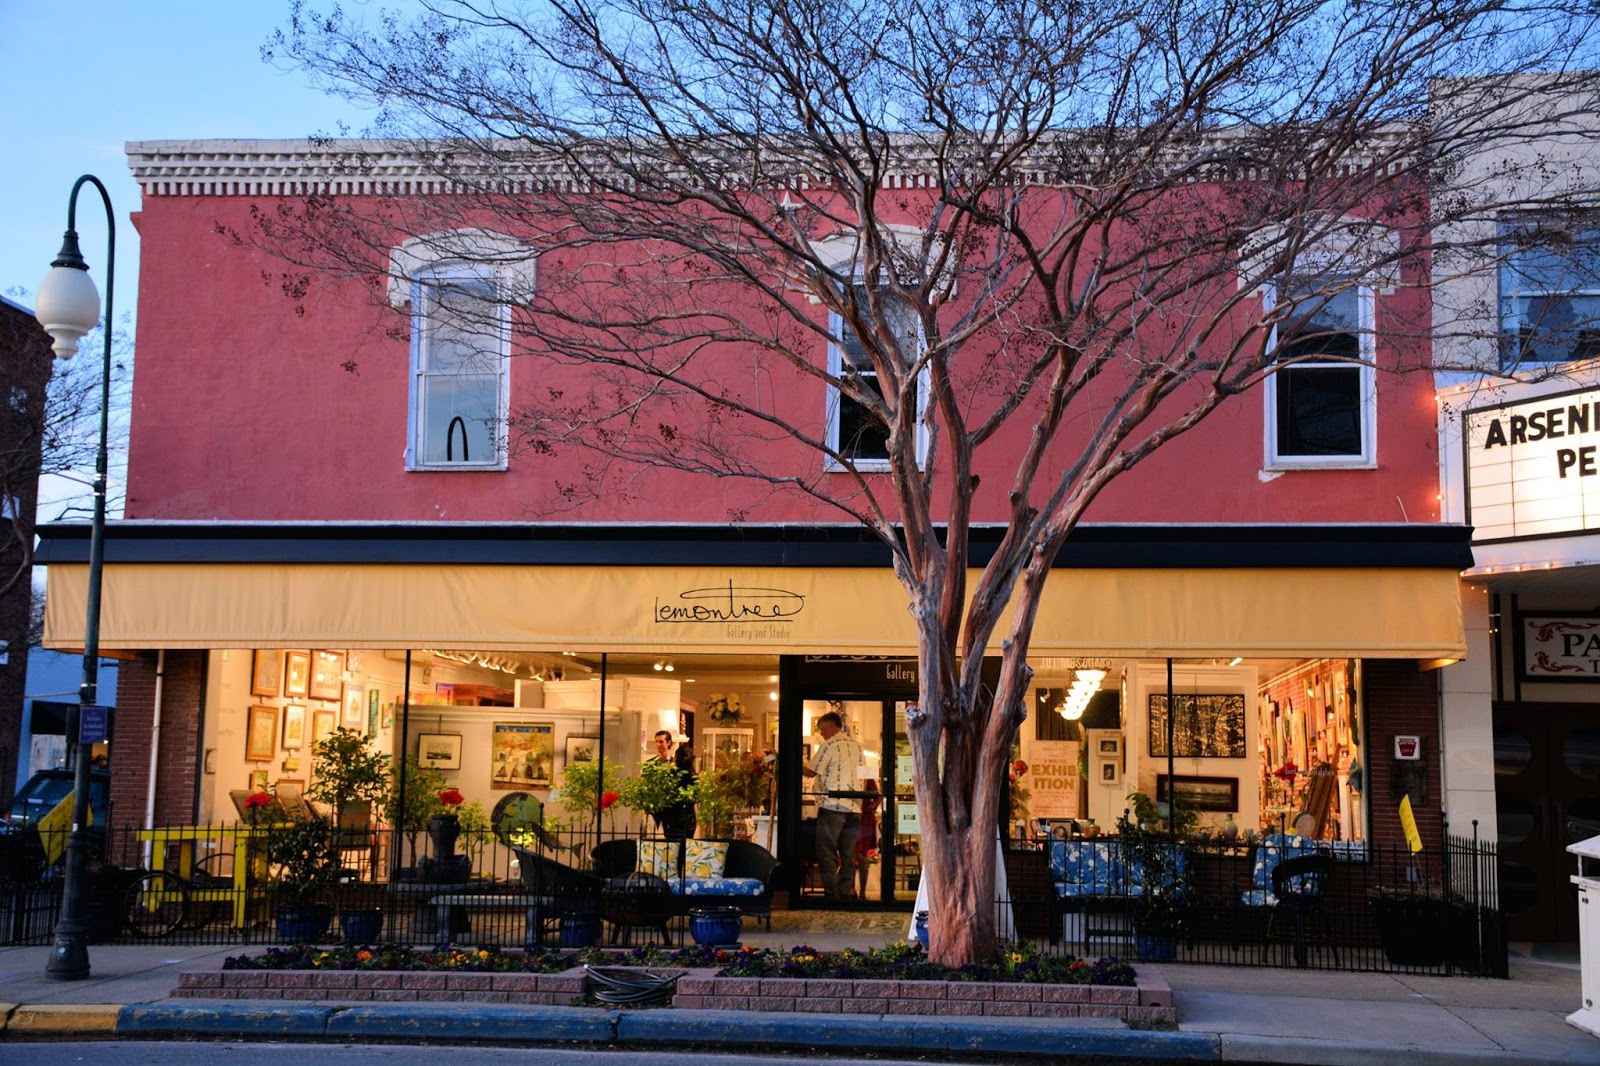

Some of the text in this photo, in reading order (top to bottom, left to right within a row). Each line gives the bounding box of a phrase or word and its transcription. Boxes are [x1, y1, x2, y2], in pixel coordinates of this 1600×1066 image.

[1557, 446, 1597, 478] PE
[727, 624, 791, 641] Gallery and Studio
[886, 663, 916, 683] Gallery
[1031, 764, 1076, 777] EXHIB
[1034, 777, 1075, 790] ITION
